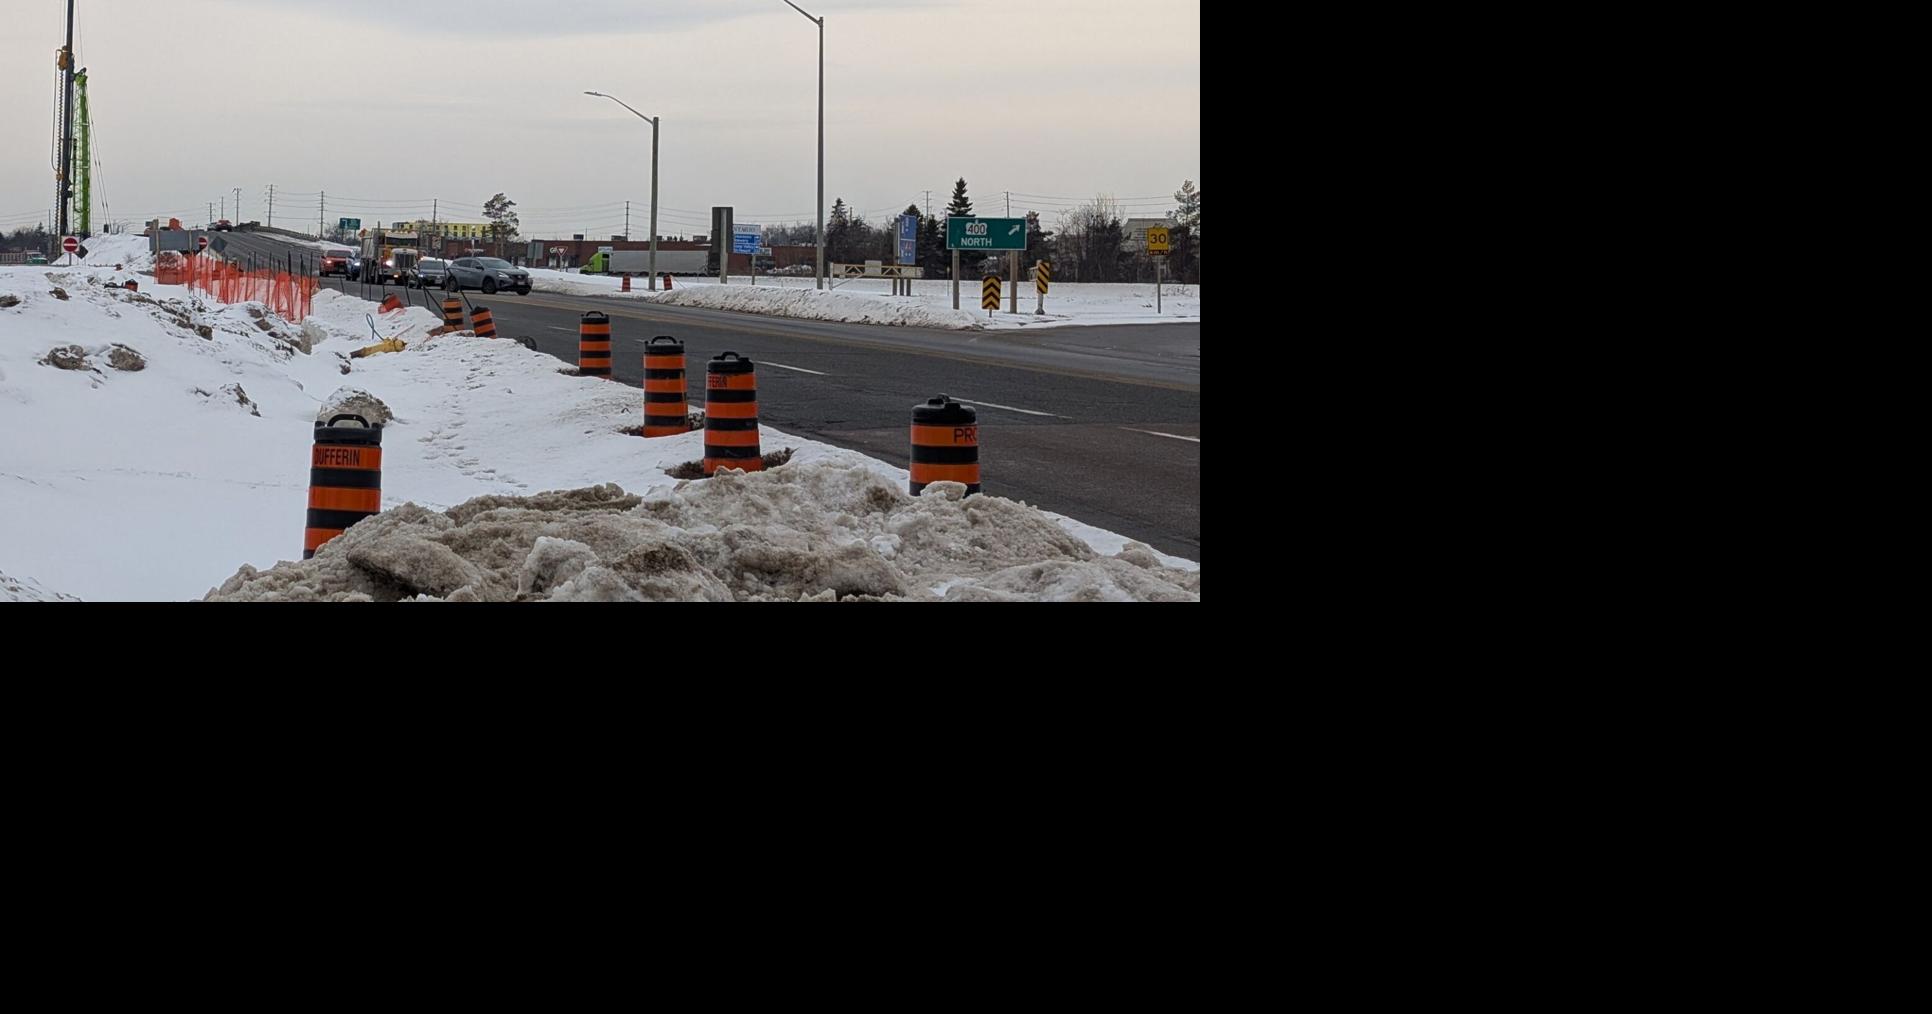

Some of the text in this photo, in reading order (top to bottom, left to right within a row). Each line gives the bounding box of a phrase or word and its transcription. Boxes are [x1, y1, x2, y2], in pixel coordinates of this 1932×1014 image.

[968, 224, 986, 234] 400
[961, 237, 992, 247] NORTH
[1150, 233, 1167, 244] 30
[314, 448, 361, 466] DUFFERIN
